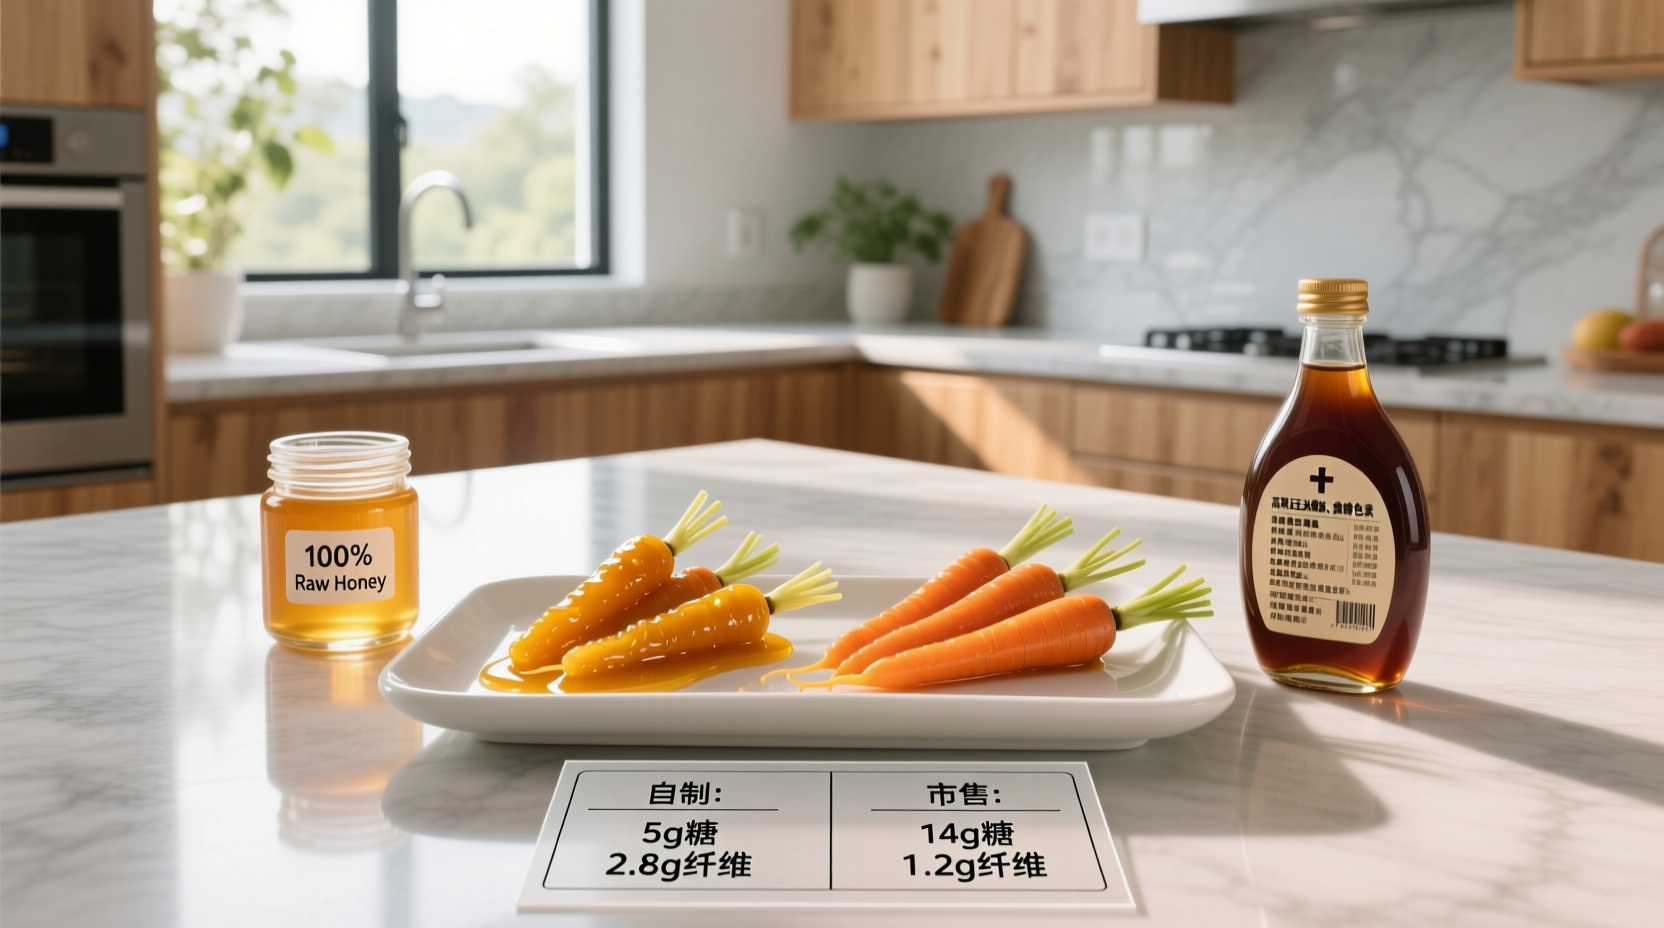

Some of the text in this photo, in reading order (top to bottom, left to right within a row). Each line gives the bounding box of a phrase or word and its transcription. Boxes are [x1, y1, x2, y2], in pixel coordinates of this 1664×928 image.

[304, 543, 373, 568] 100%
[295, 573, 387, 594] Raw Honey
[642, 819, 719, 850] 5g糖
[920, 820, 1015, 850] 14g糖
[605, 850, 753, 883] 2.8g纤维
[903, 851, 1048, 883] 1.2g纤维
